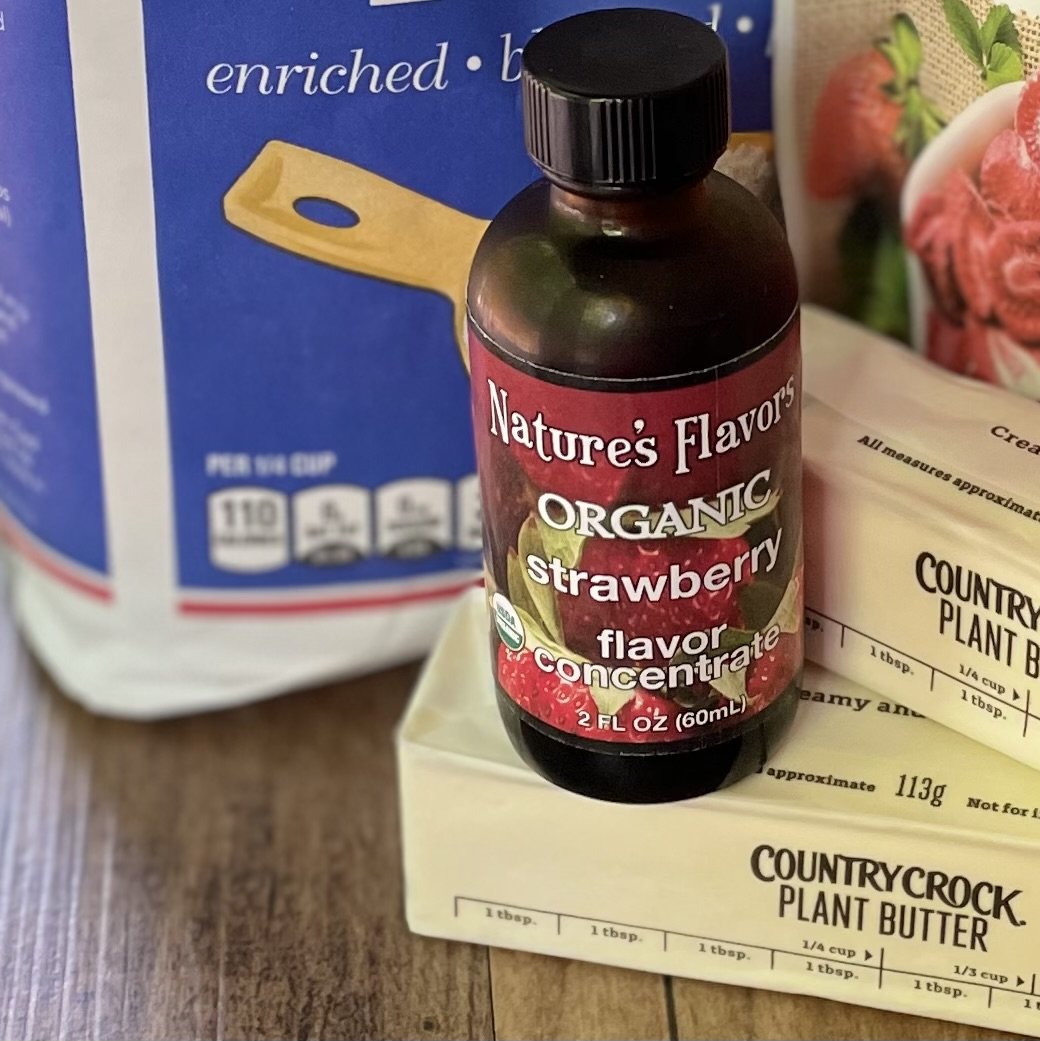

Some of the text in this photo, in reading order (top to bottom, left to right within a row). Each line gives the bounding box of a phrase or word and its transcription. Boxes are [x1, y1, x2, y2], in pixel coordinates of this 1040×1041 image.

[206, 42, 449, 96] enriched
[487, 374, 795, 474] Nature's Flavors
[857, 434, 882, 452] All
[882, 443, 952, 483] measures
[537, 469, 772, 540] ORGANIC
[526, 527, 783, 603] strawberry
[597, 623, 728, 661] flavor
[939, 598, 1017, 666] PLANT
[534, 623, 780, 691] concentrate
[871, 645, 914, 676] 1 tbsp.
[958, 663, 1007, 696] 1/4 cup
[577, 696, 747, 733] 2 FL OZ (60mL)
[800, 690, 870, 711] eamy
[960, 689, 1008, 721] 1 tbsp.
[767, 767, 876, 793] approximate
[895, 774, 947, 807] 113g
[966, 796, 996, 813] Not
[1002, 803, 1029, 819] for
[485, 907, 537, 927] 1 tbsp.
[778, 884, 989, 952] PLANT BUTTER
[591, 924, 644, 944] 1 tbsp.
[802, 939, 857, 960] 1/4 cup
[699, 942, 752, 961] 1 tbsp.
[806, 962, 859, 980] 1 tbsp.
[953, 964, 1009, 984] 1/3 cup
[914, 980, 968, 999] 1 tbsp.
[1024, 999, 1031, 1010] 1
